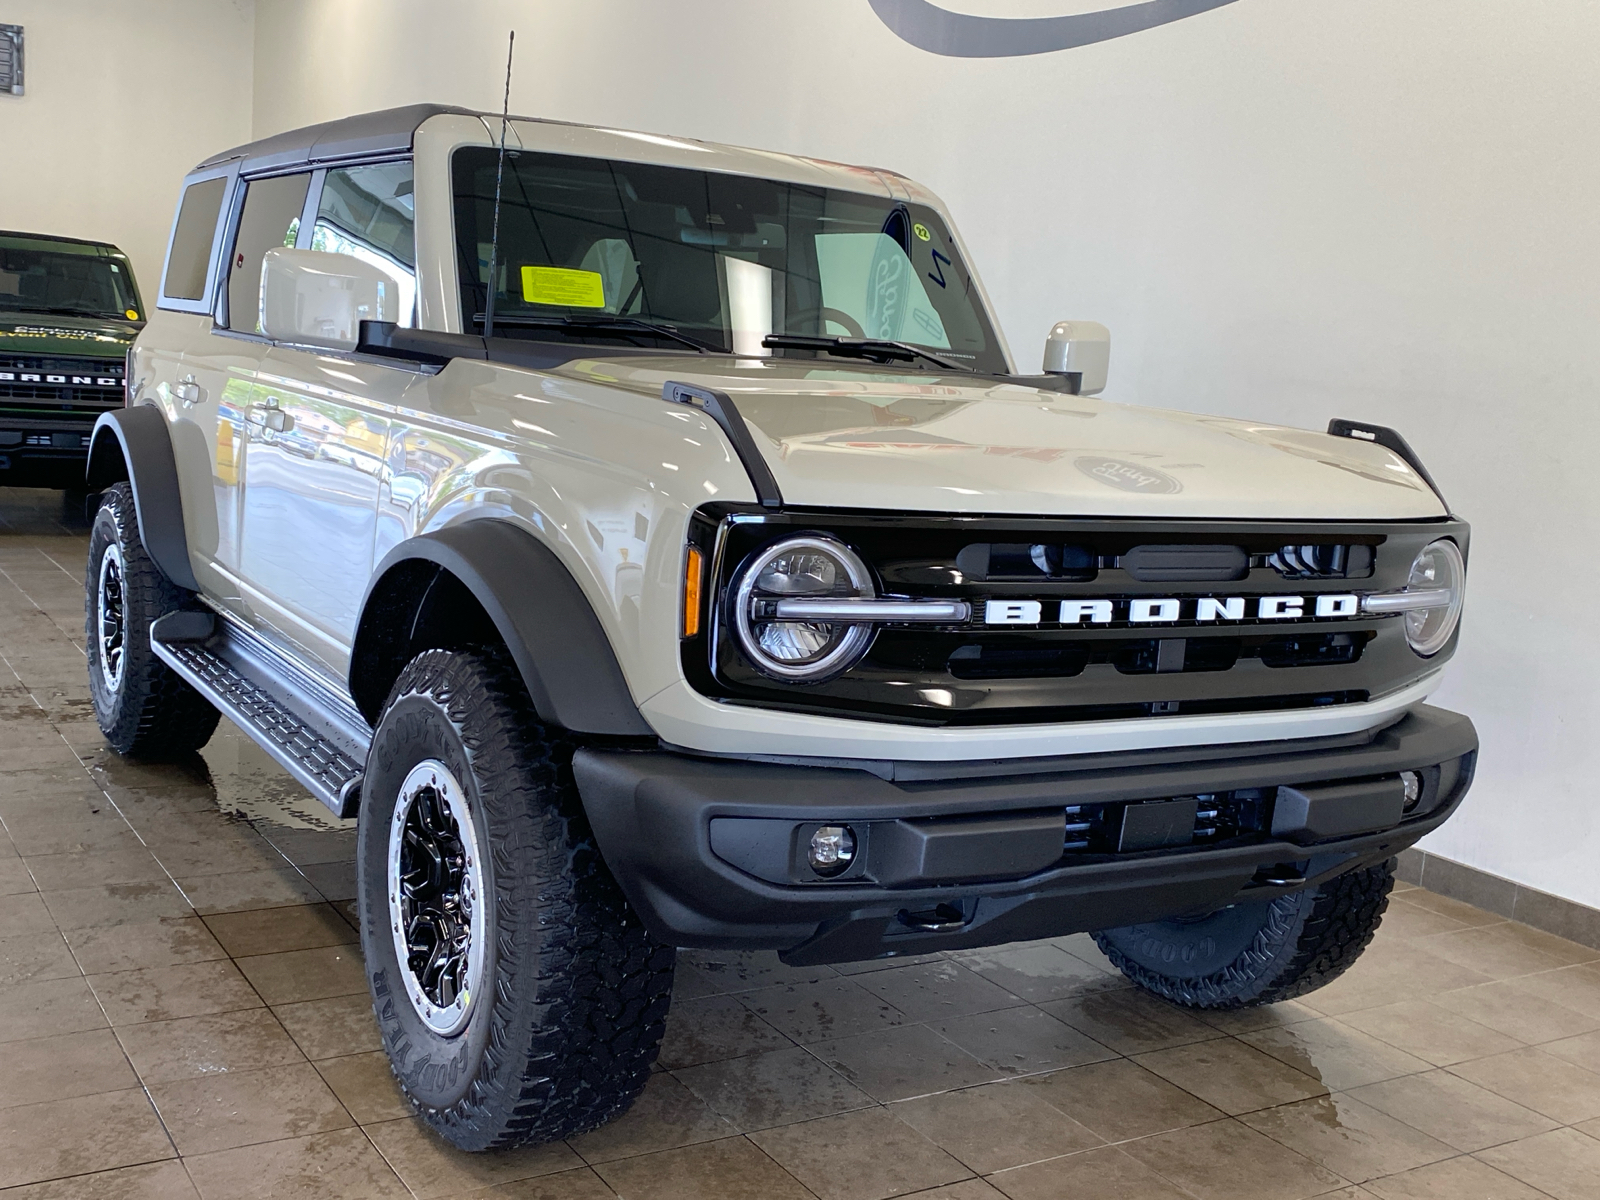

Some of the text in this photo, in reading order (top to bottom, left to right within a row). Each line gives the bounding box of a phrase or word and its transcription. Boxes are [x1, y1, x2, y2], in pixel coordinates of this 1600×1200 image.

[916, 226, 929, 239] 22
[0, 372, 126, 386] BRONC
[985, 594, 1358, 625] BRONCO
[373, 967, 468, 1093] GOODYEAR
